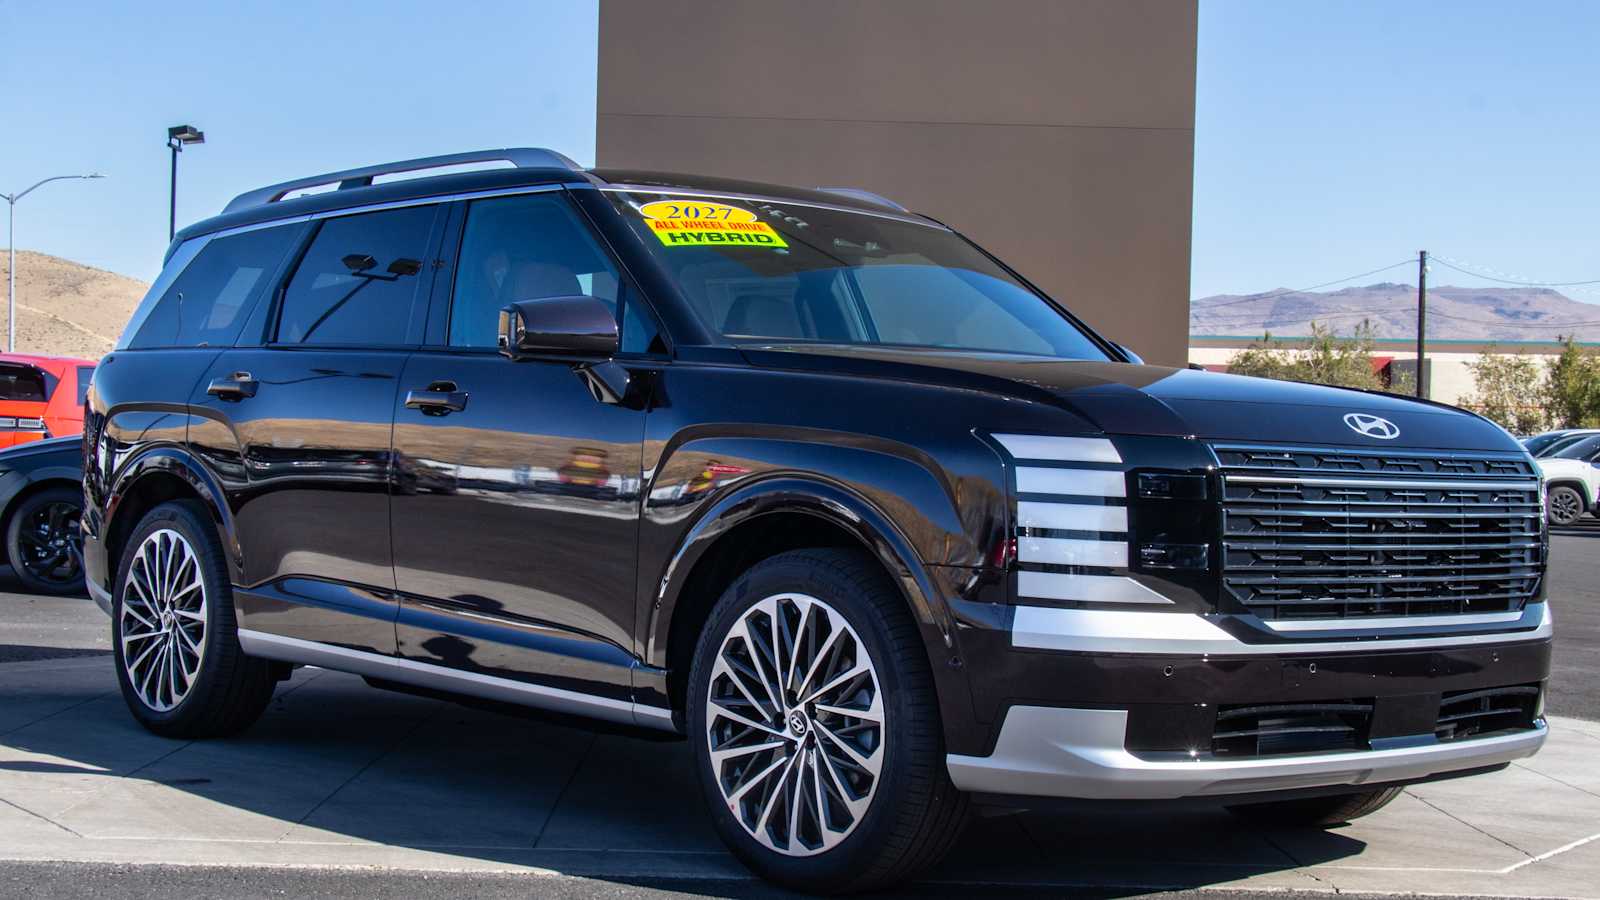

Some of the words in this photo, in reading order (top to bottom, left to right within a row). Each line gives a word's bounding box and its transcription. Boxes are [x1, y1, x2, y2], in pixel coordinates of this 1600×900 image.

[665, 205, 732, 219] 2027
[655, 220, 679, 229] ALL
[681, 220, 727, 230] WHEEL
[728, 222, 767, 231] DRIVE
[668, 232, 773, 243] HYBRID
